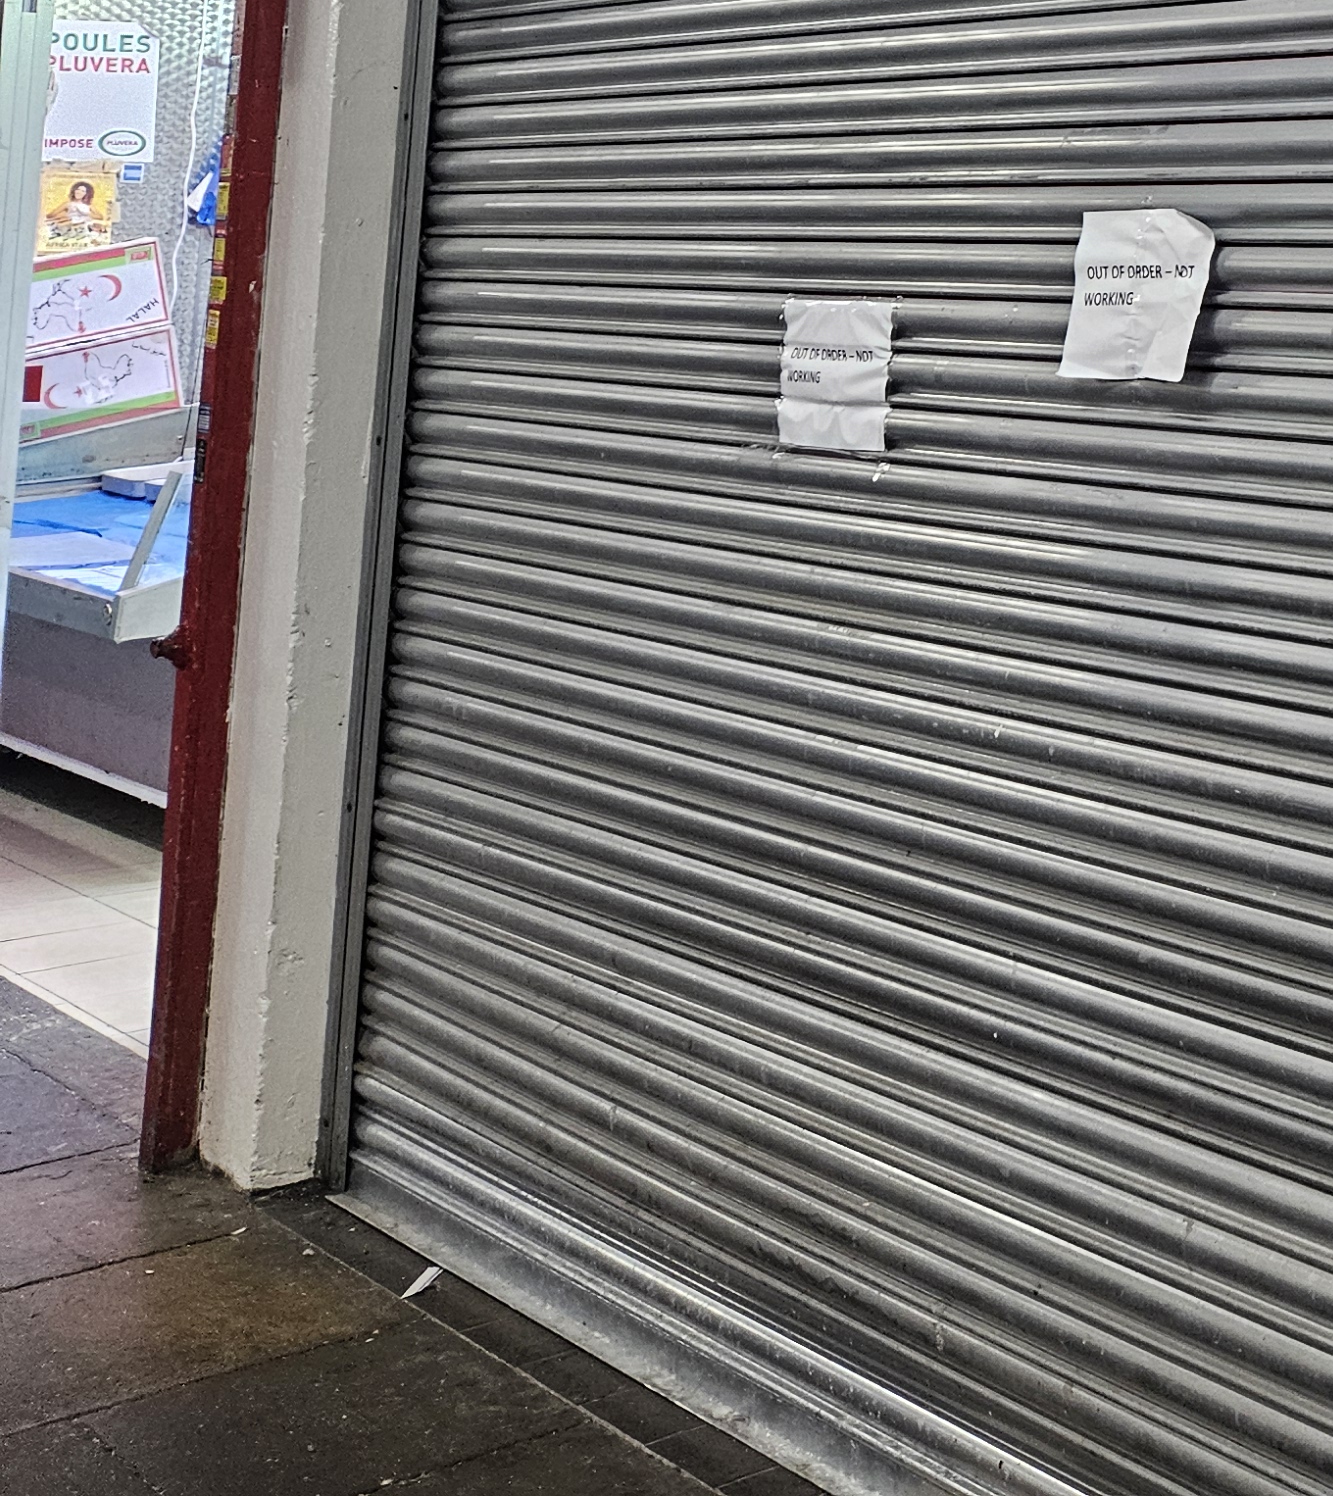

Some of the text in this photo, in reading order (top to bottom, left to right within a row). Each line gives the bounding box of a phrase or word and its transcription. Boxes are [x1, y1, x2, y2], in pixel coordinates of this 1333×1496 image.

[1087, 266, 1109, 279] OUT
[1112, 265, 1125, 279] OF
[1127, 265, 1163, 279] ORDER
[1174, 264, 1195, 279] NOT
[1084, 292, 1134, 306] WORKING
[125, 297, 160, 322] HALAL
[791, 347, 809, 359] OUT
[809, 348, 820, 361] OF
[821, 348, 847, 362] ORDER
[856, 350, 873, 363] NOT
[787, 369, 821, 384] WORKING
